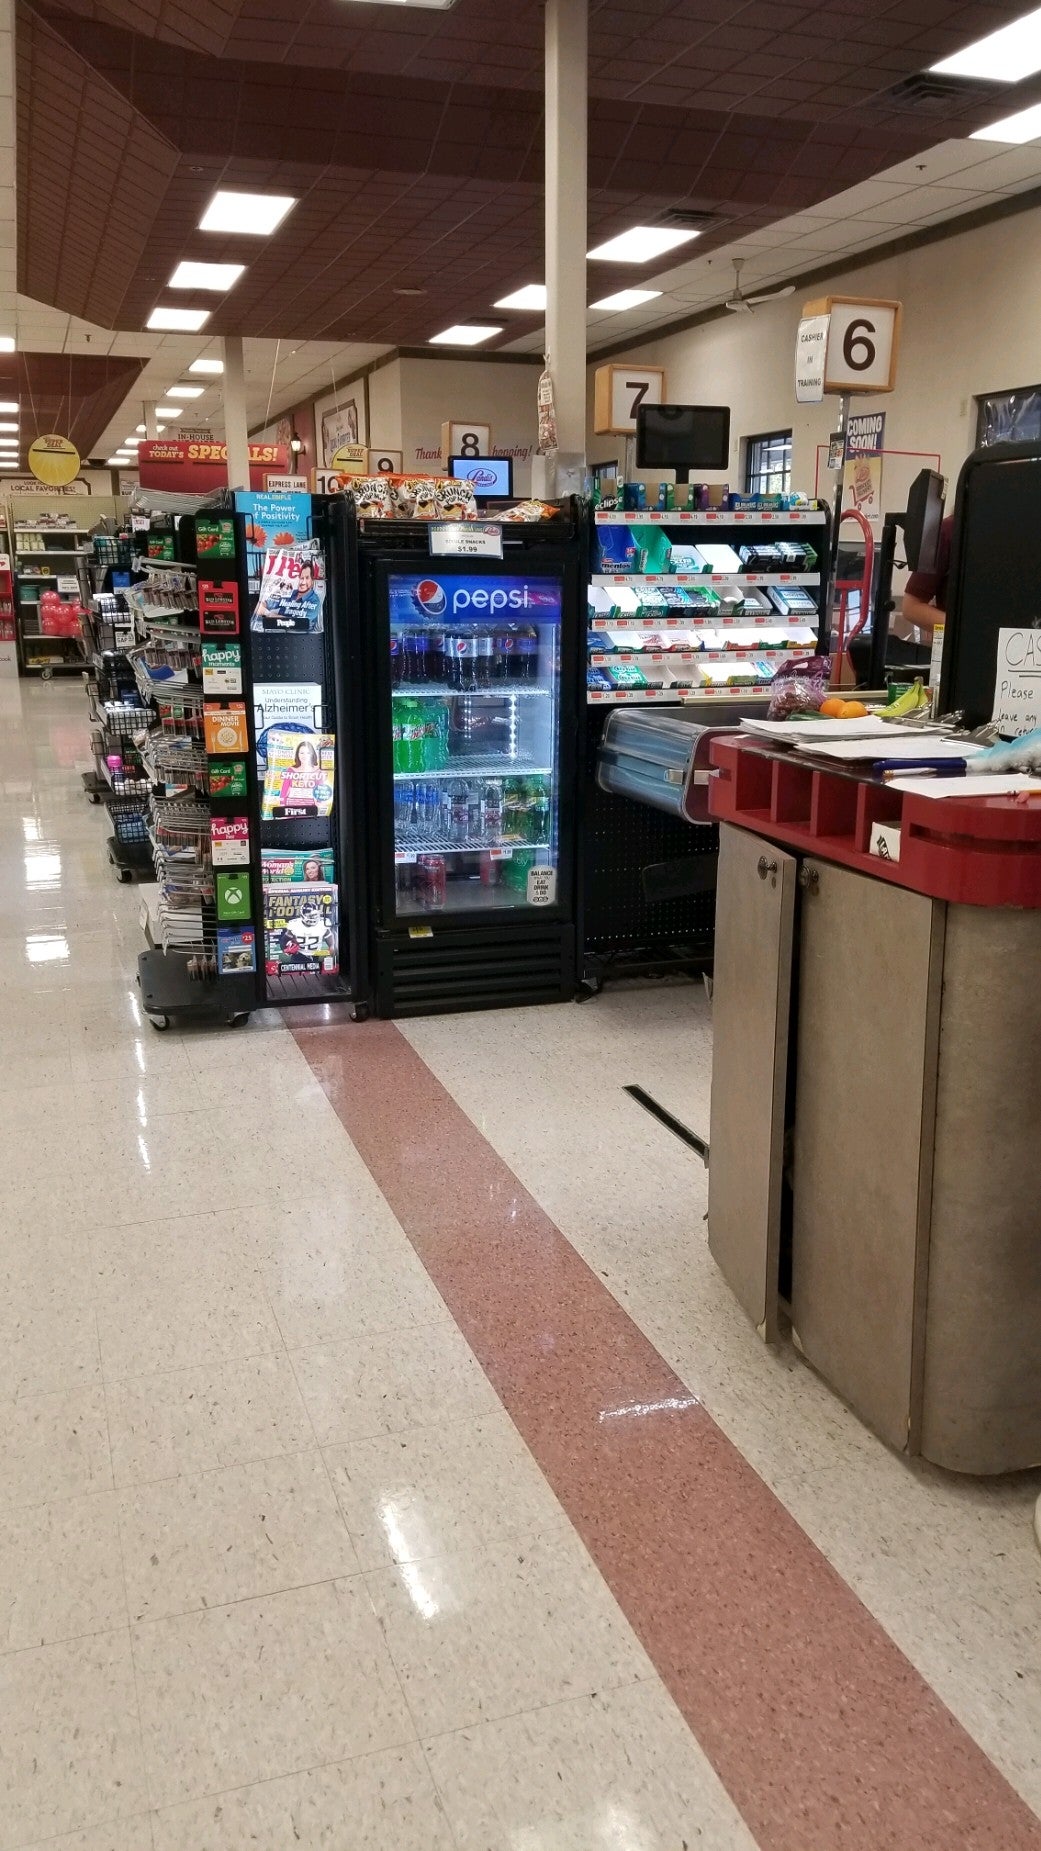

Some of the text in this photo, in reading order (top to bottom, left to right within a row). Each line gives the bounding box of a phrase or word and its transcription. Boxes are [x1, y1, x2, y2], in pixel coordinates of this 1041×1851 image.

[801, 332, 823, 343] CASHIER
[843, 318, 876, 371] 6
[807, 355, 814, 364] IN
[798, 378, 821, 387] TRAINING
[625, 382, 649, 419] 7
[847, 415, 882, 437] COMING
[177, 433, 214, 441] IN-HOUSE
[849, 433, 877, 453] SOON!
[461, 433, 479, 456] 8
[149, 444, 279, 462] TODAY'S SPECLS!
[415, 447, 442, 459] Thank
[268, 480, 306, 489] EXPRESS LANE
[436, 486, 473, 502] CRUNCH
[253, 503, 296, 512] The Power
[595, 496, 623, 511] eclipse
[261, 512, 300, 522] Positivity
[279, 599, 318, 610] Healing After
[453, 584, 529, 614] pepsi
[202, 648, 241, 663] happy
[1001, 680, 1034, 699] Please
[256, 703, 315, 713] Alzheimer's
[1025, 714, 1037, 726] any
[281, 772, 328, 780] SHORTCUT
[291, 780, 316, 788] KETO
[284, 808, 307, 816] First
[211, 822, 249, 836] happy
[268, 894, 323, 907] FANTASY
[268, 904, 332, 917] FOOTLL
